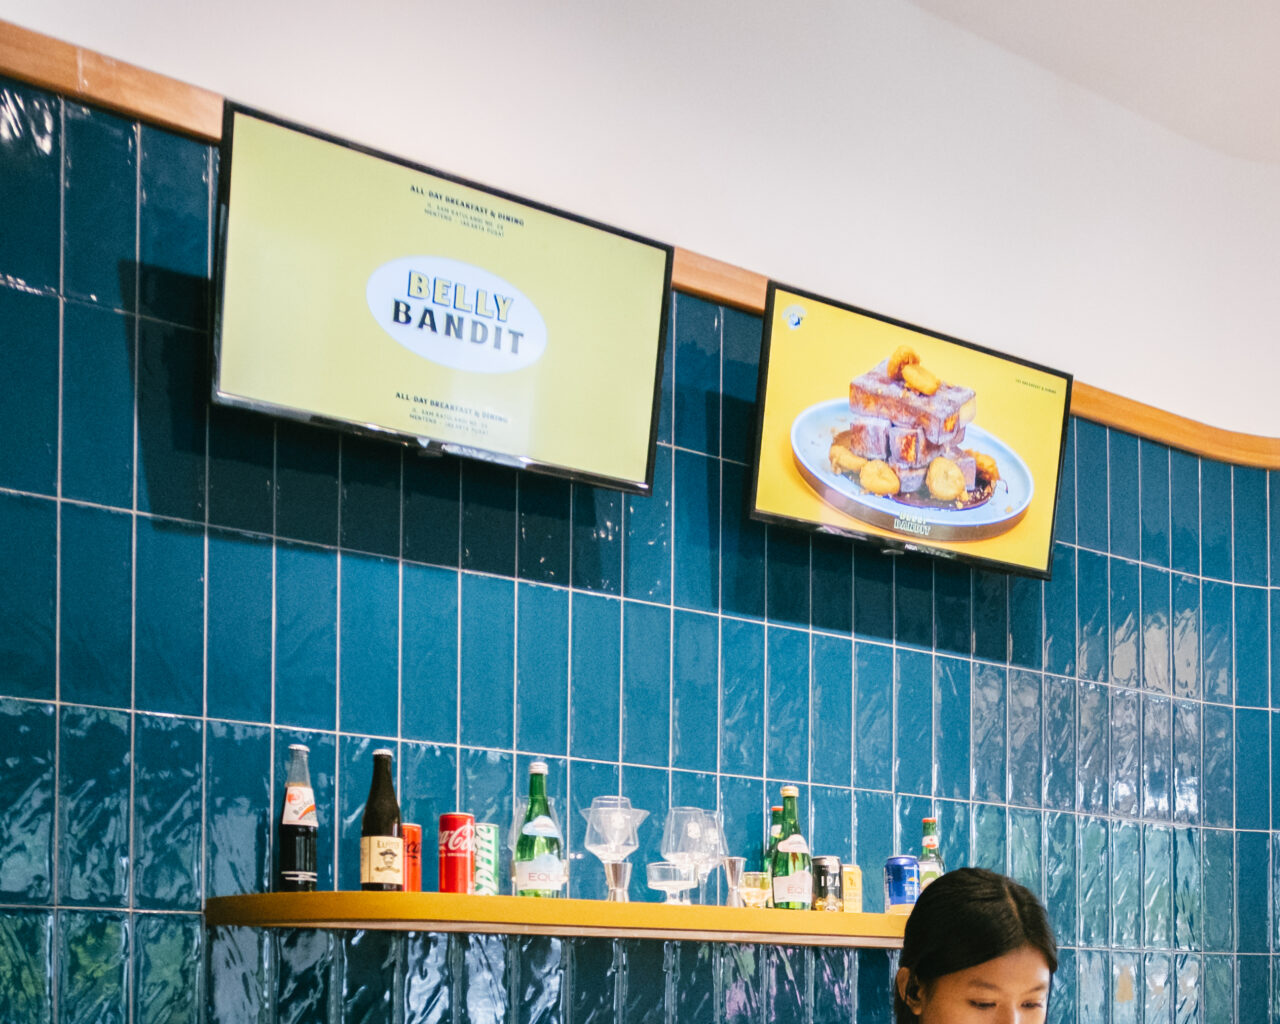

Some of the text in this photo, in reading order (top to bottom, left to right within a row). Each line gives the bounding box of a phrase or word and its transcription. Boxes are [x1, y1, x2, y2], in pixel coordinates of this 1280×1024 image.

[410, 185, 424, 195] ALL
[428, 190, 443, 200] DAY
[445, 195, 488, 214] BREAKFAST
[498, 212, 525, 226] DINING
[407, 269, 514, 323] BELLY
[393, 298, 524, 354] BANDIT
[396, 392, 410, 401] ALL
[413, 396, 428, 405] DAY
[430, 400, 472, 416] BREAKFAST
[821, 875, 840, 887] IPA
